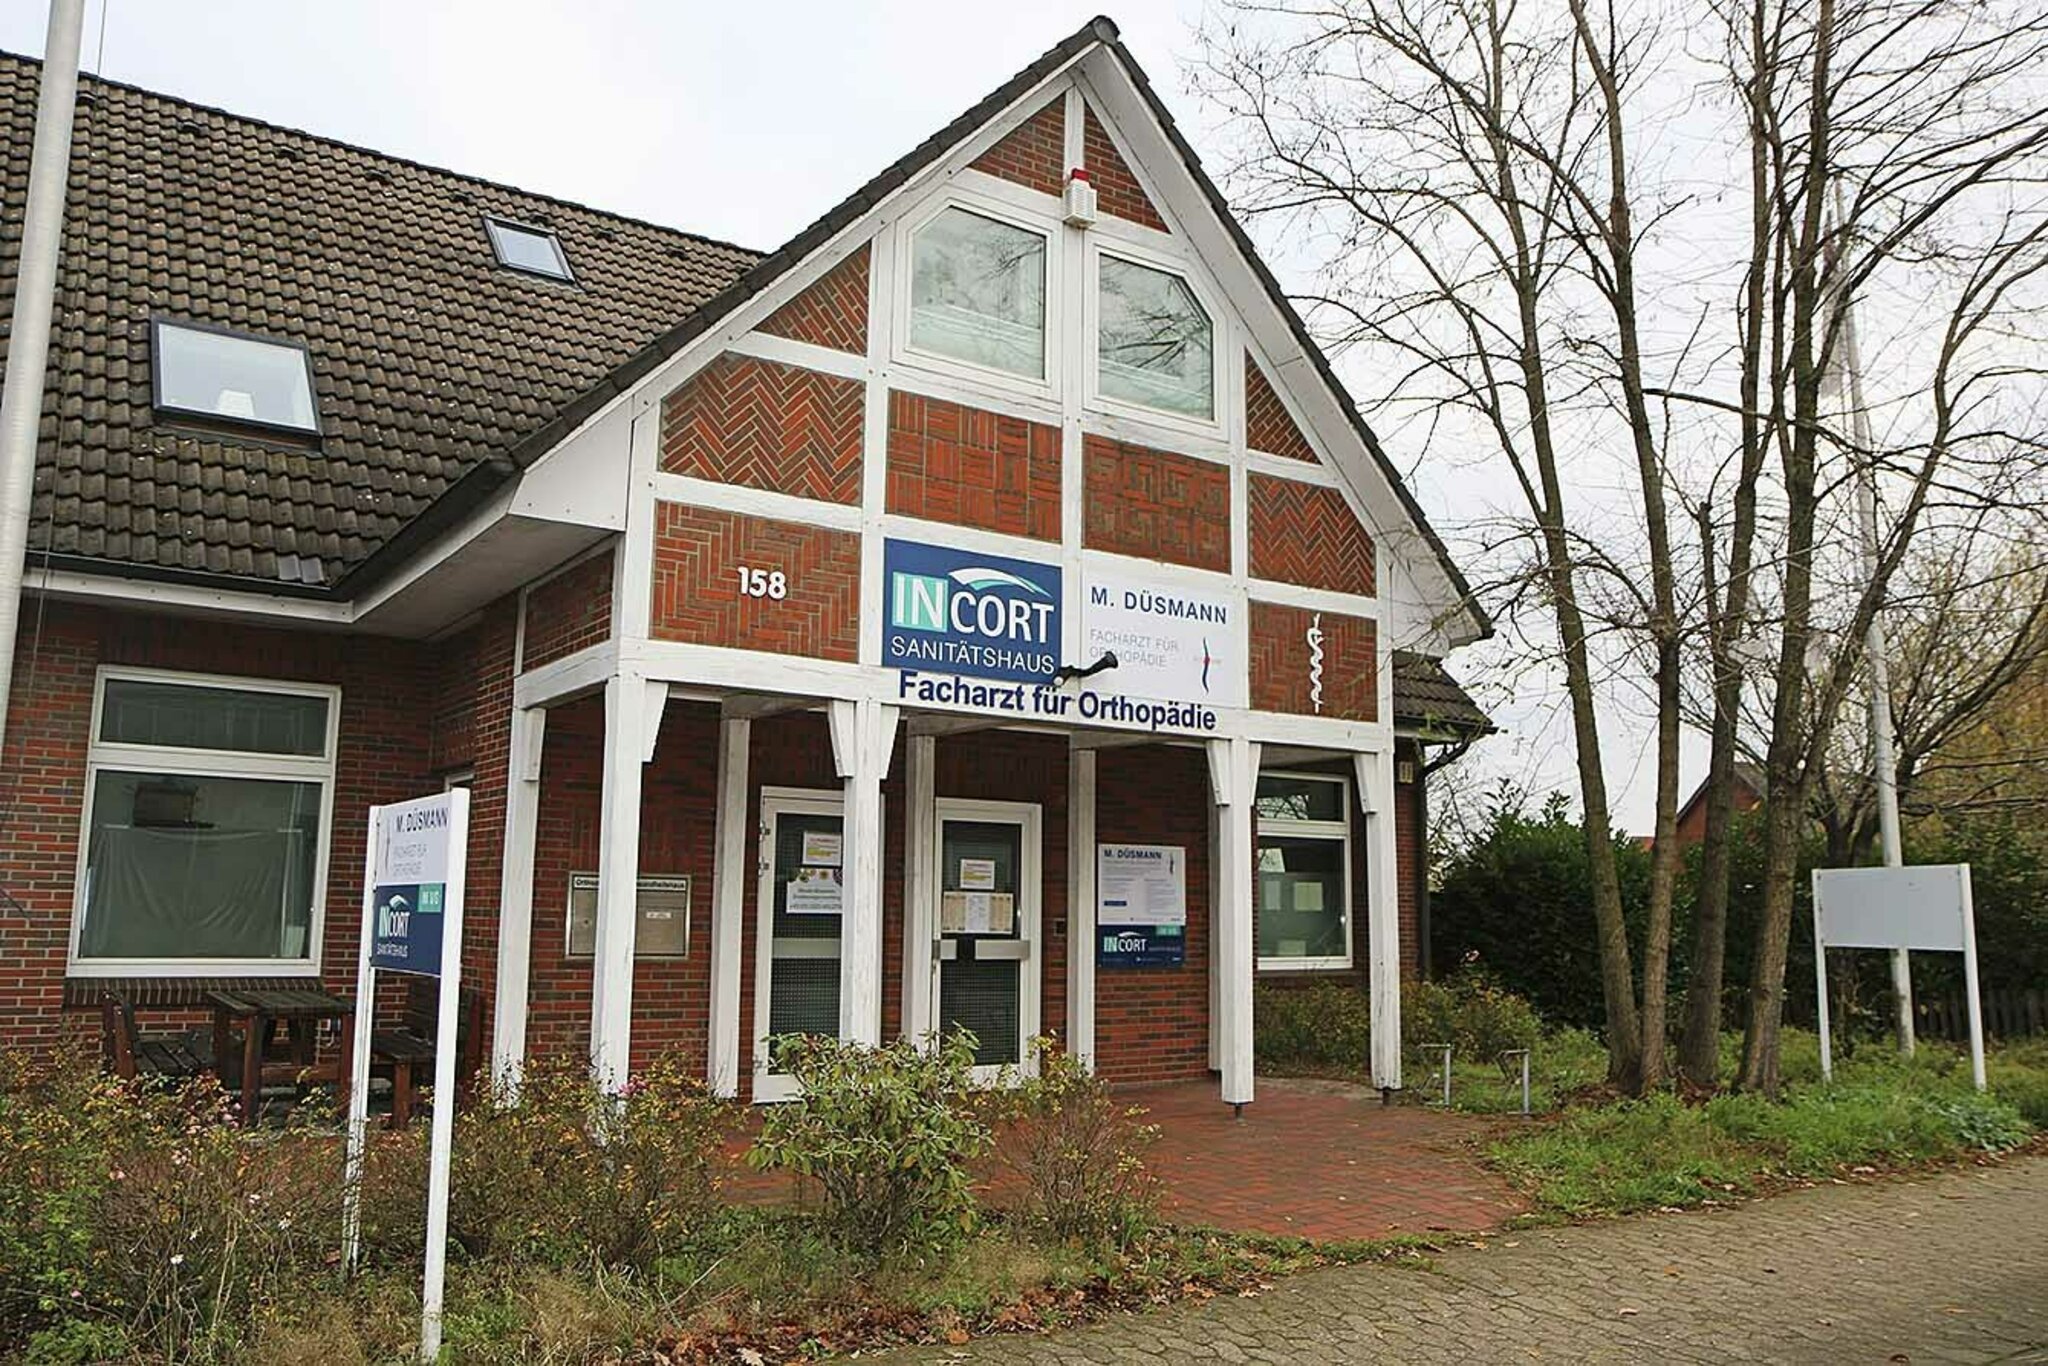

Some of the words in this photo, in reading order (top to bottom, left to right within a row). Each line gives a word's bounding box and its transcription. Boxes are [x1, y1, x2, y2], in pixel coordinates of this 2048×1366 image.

[737, 566, 787, 600] 158
[894, 573, 1054, 644] INCORT
[1091, 586, 1114, 607] M.
[1125, 590, 1226, 624] DÜSMANN
[891, 635, 1055, 675] SANITÄTSHAUS
[1089, 628, 1151, 649] FACHARZT
[1155, 636, 1178, 652] FÜR
[899, 669, 1025, 710] Facharzt
[1033, 685, 1072, 715] für
[1079, 691, 1217, 731] Orthopädie
[407, 807, 448, 831] DÜSMANN
[1117, 847, 1162, 860] DÜSMANN
[379, 905, 410, 937] INCORT
[1103, 936, 1147, 953] INCORT
